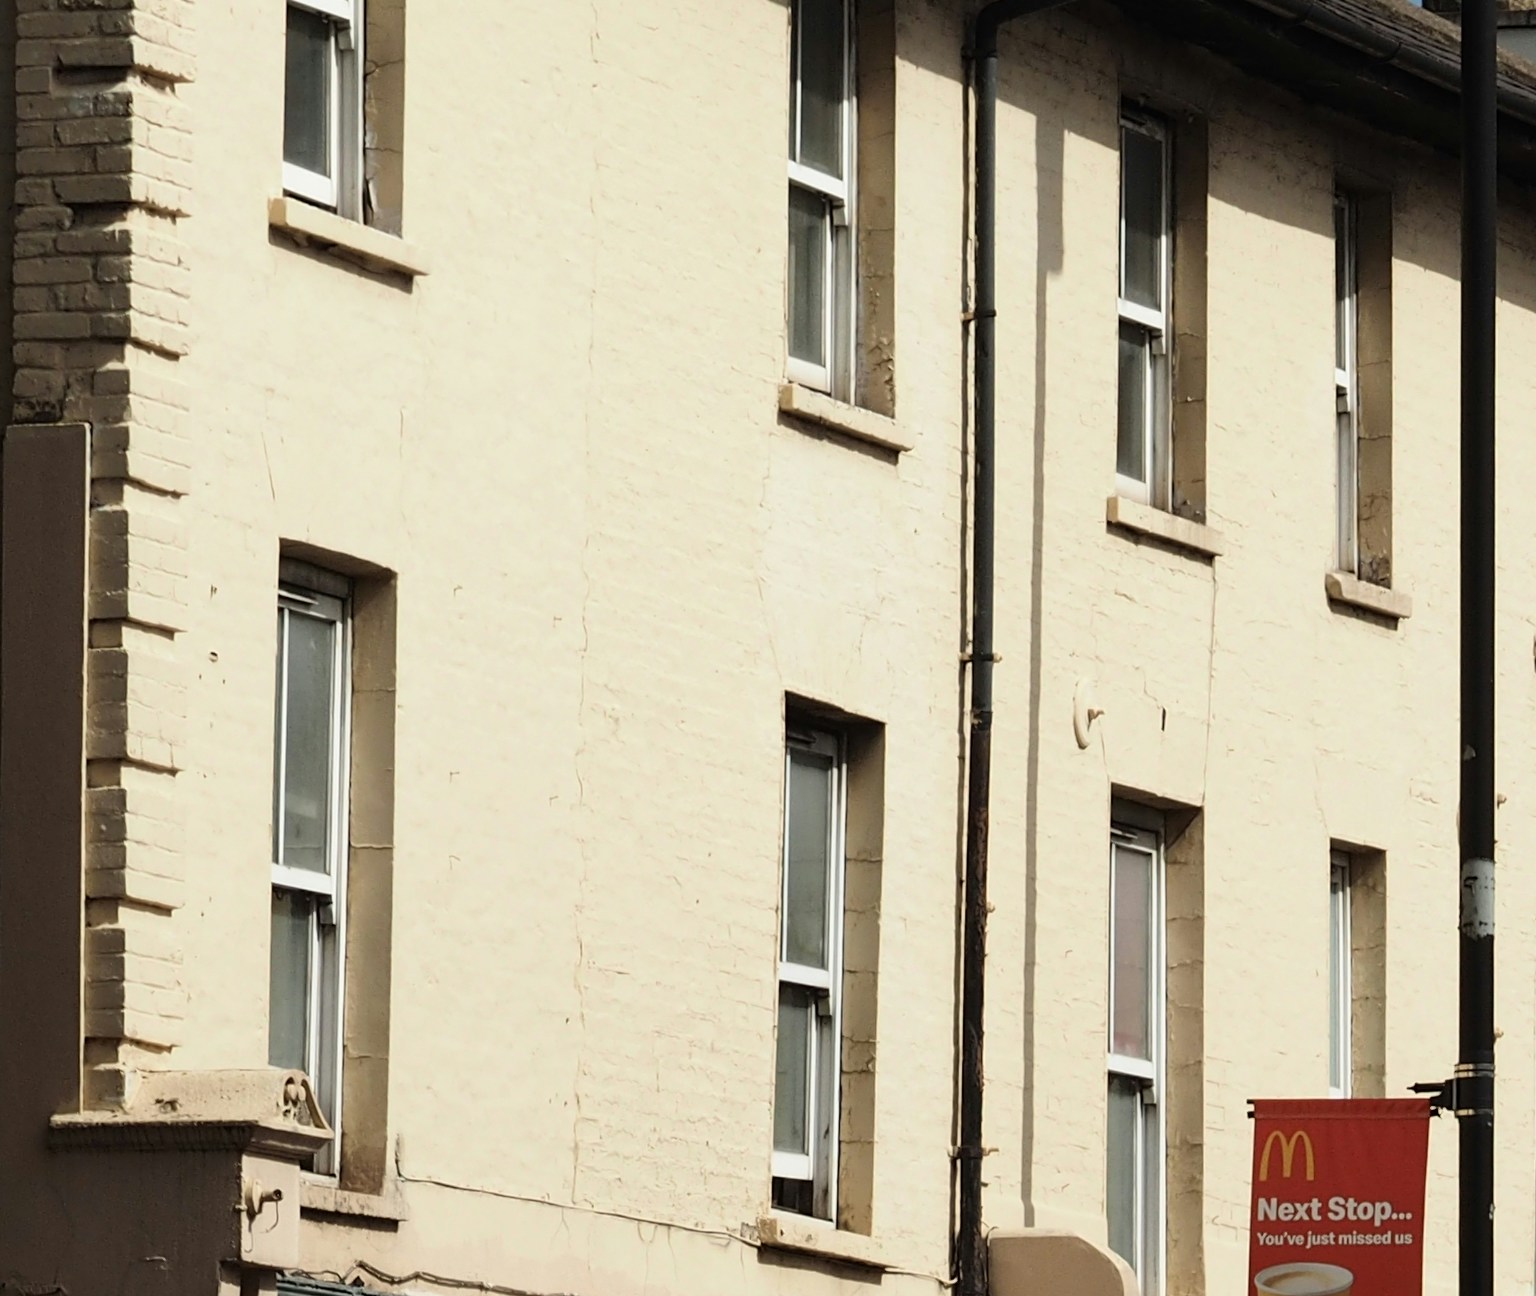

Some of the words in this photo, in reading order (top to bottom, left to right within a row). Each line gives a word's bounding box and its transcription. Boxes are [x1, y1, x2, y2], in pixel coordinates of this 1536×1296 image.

[1257, 1196, 1322, 1222] Next
[1327, 1195, 1413, 1228] Stop...
[1257, 1231, 1305, 1246] You've
[1306, 1230, 1336, 1249] just
[1338, 1230, 1392, 1246] missed
[1394, 1232, 1413, 1245] us
